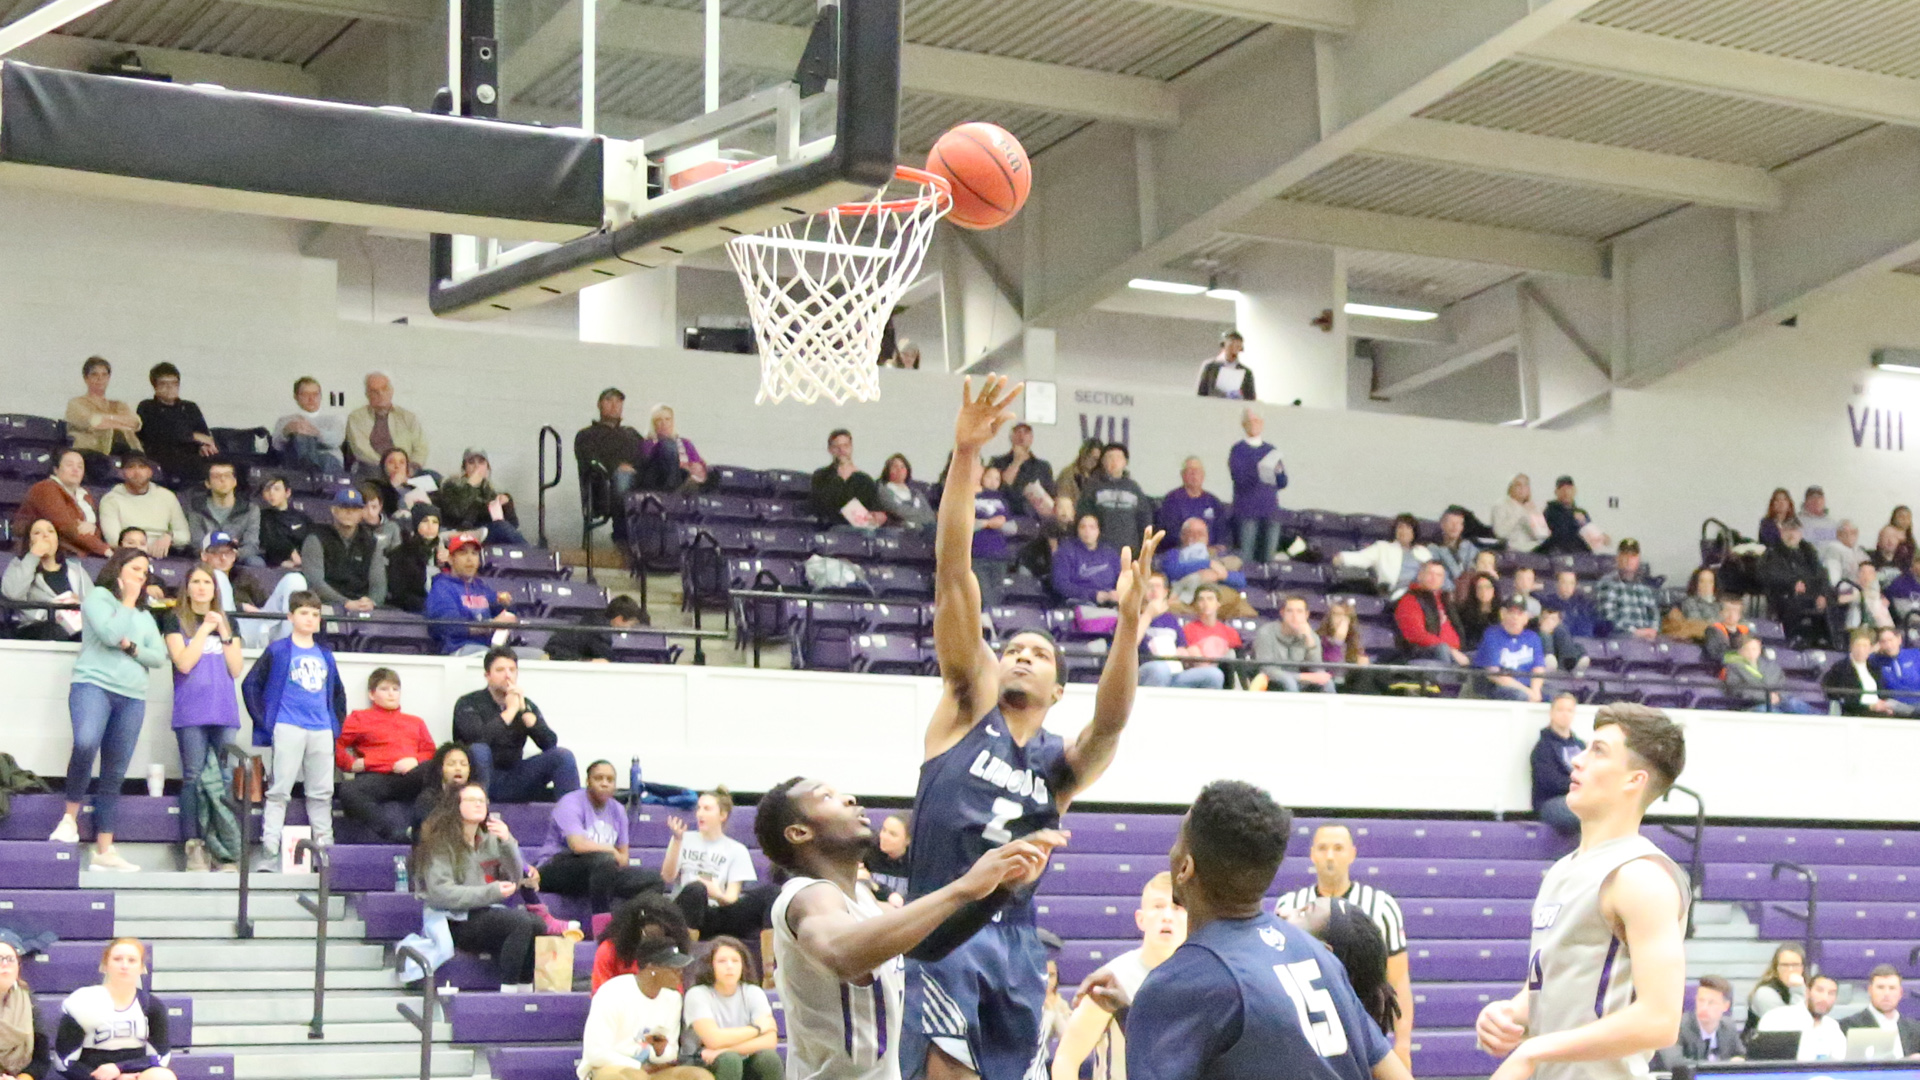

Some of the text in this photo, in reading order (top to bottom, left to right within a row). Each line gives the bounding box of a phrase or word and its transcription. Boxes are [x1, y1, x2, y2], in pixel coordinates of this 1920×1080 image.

[1074, 390, 1134, 407] SECTION
[1079, 413, 1130, 447] VII
[1847, 404, 1904, 452] VIII
[981, 796, 1024, 845] 2
[1272, 958, 1348, 1058] 15
